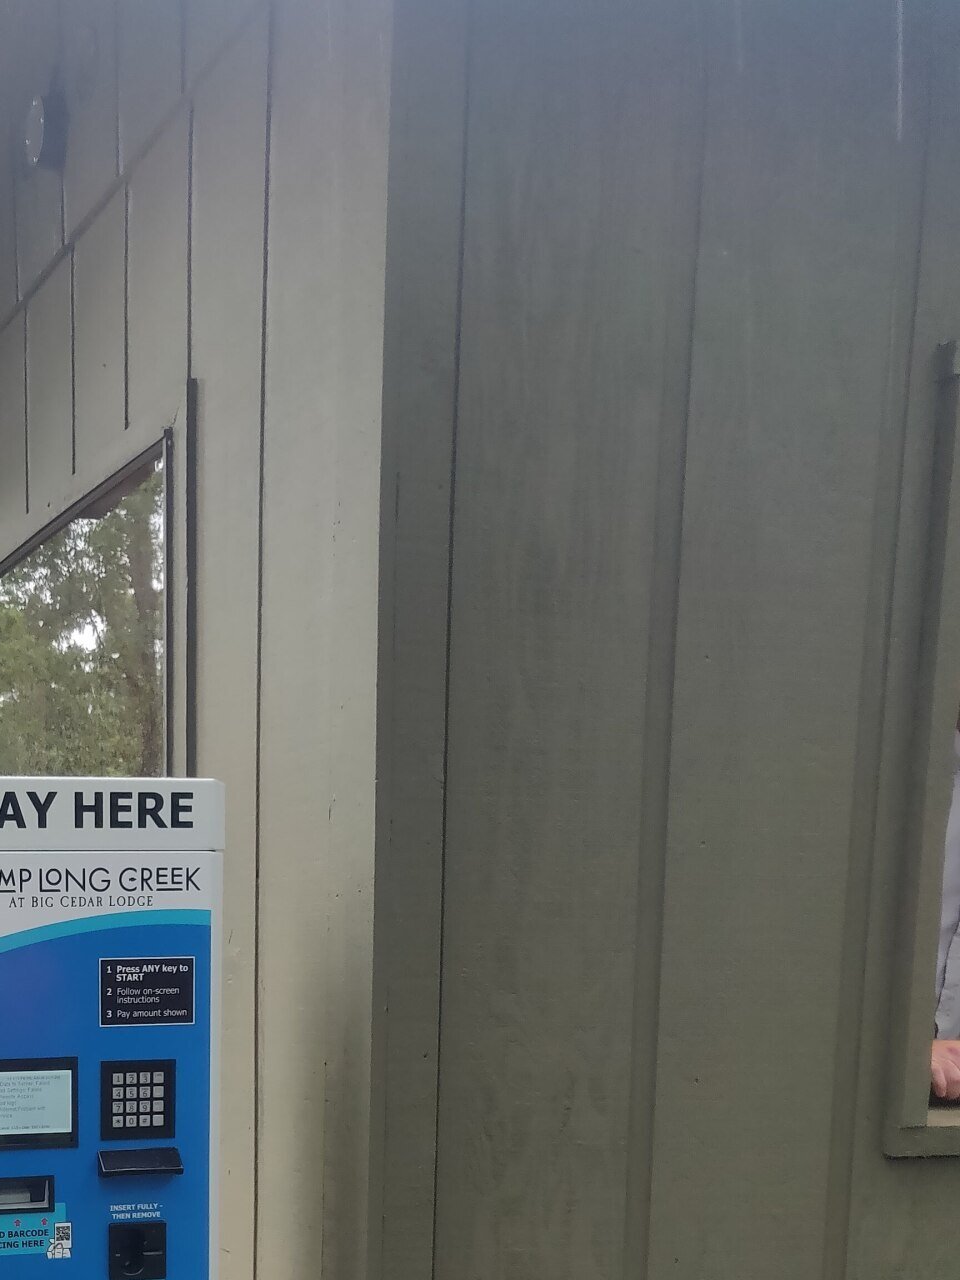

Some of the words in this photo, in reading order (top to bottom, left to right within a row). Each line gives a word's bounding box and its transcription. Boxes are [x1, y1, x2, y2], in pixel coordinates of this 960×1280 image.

[74, 791, 194, 829] HERE
[39, 867, 111, 893] LONG
[119, 866, 201, 892] CREEK
[9, 896, 25, 908] AT
[31, 896, 54, 908] BIG
[60, 895, 103, 907] CEDAR
[109, 895, 154, 907] LODGE
[106, 965, 112, 973] 1
[116, 965, 140, 973] Press
[142, 964, 160, 973] ANY
[162, 964, 177, 974] key
[179, 964, 189, 972] to
[116, 973, 144, 982] START
[106, 988, 112, 996] 2
[116, 987, 141, 996] Follow
[143, 987, 180, 995] on-screen
[116, 996, 160, 1004] instructions
[106, 1010, 112, 1018] 3
[117, 1009, 130, 1019] Pay
[132, 1009, 161, 1017] amount
[163, 1009, 187, 1017] shown
[132, 1211, 161, 1219] REMOVE
[7, 1229, 49, 1238] BARCODE
[21, 1240, 45, 1248] HERE
